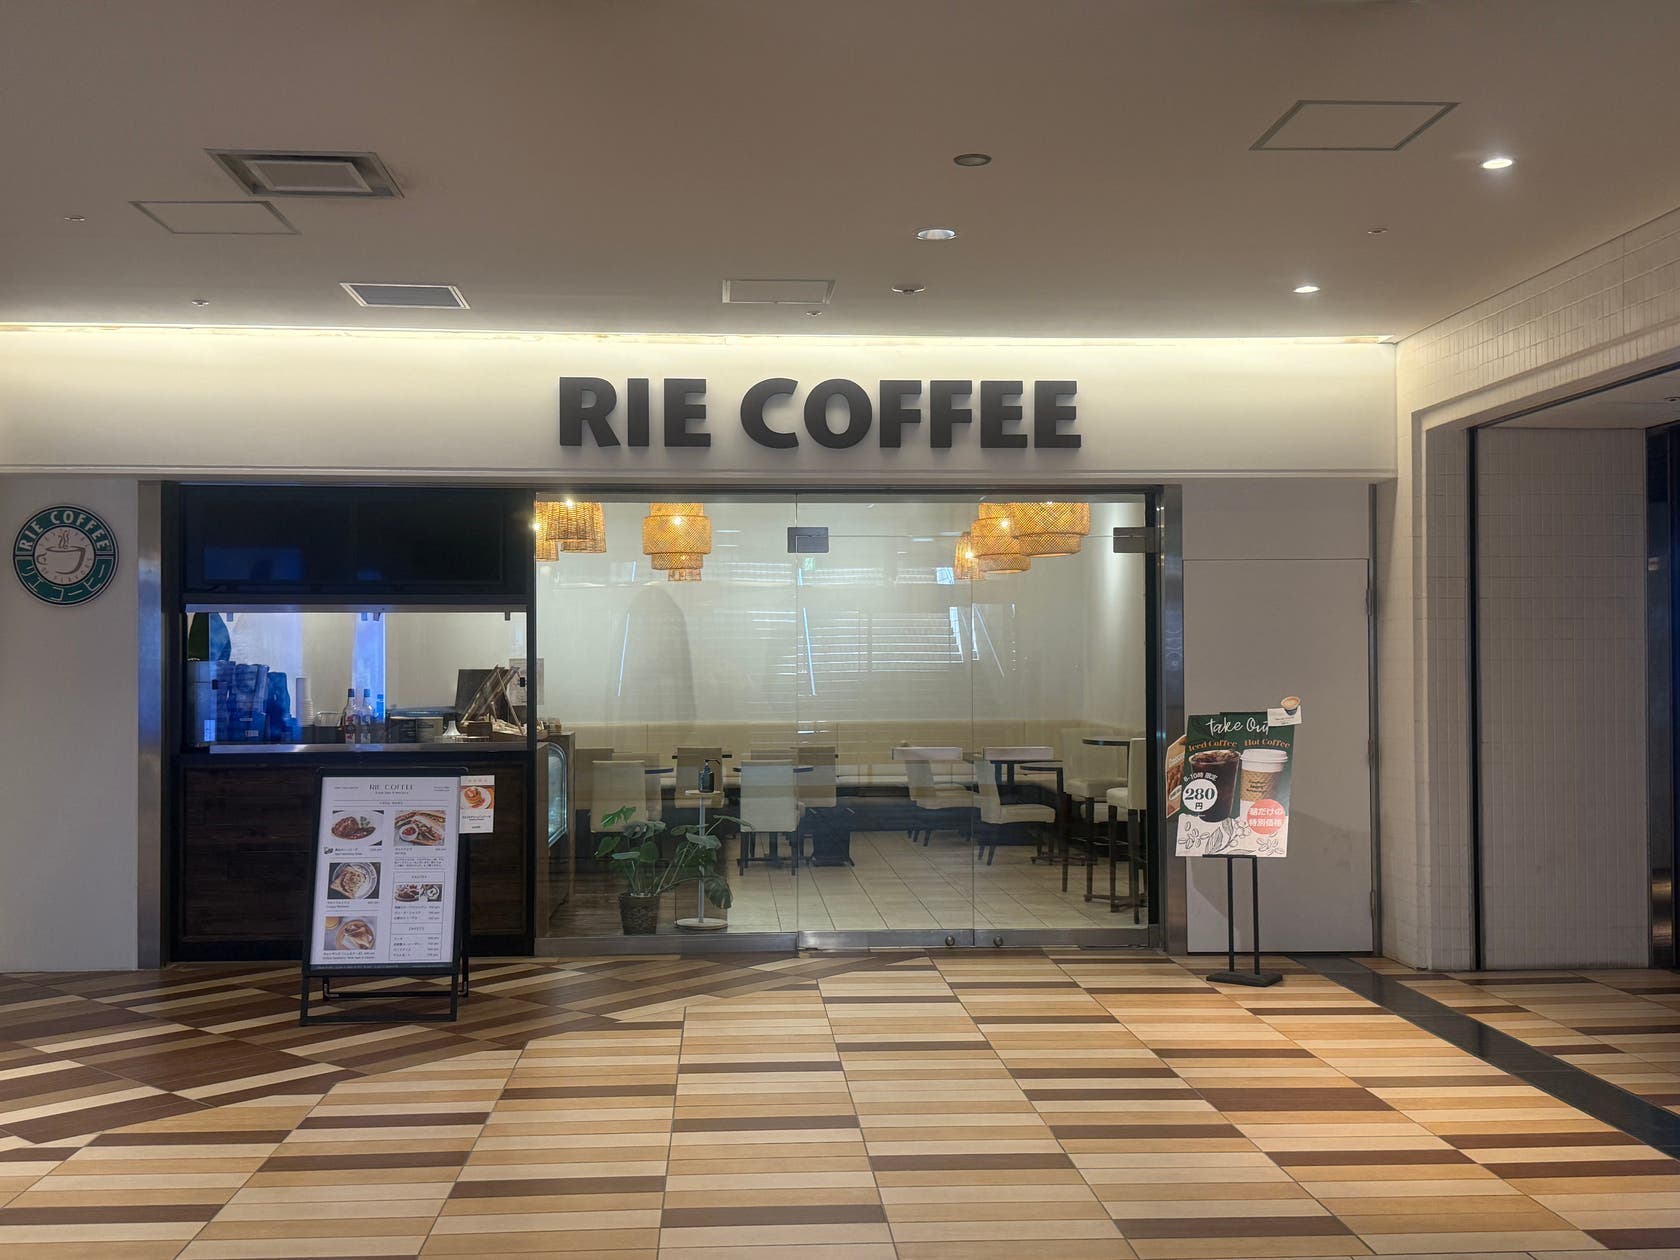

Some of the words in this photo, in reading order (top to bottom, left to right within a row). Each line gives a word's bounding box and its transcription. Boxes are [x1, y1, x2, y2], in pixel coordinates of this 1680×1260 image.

[559, 376, 711, 447] RIE
[740, 378, 1082, 449] COFFEE
[20, 521, 43, 550] RIE
[50, 511, 110, 549] COFFEE
[21, 564, 105, 602] リエコーヒー
[1188, 741, 1207, 752] Iced
[1208, 739, 1238, 747] Coffee
[1261, 739, 1291, 749] Coffee
[1185, 787, 1216, 800] 280
[1195, 802, 1203, 810] 円
